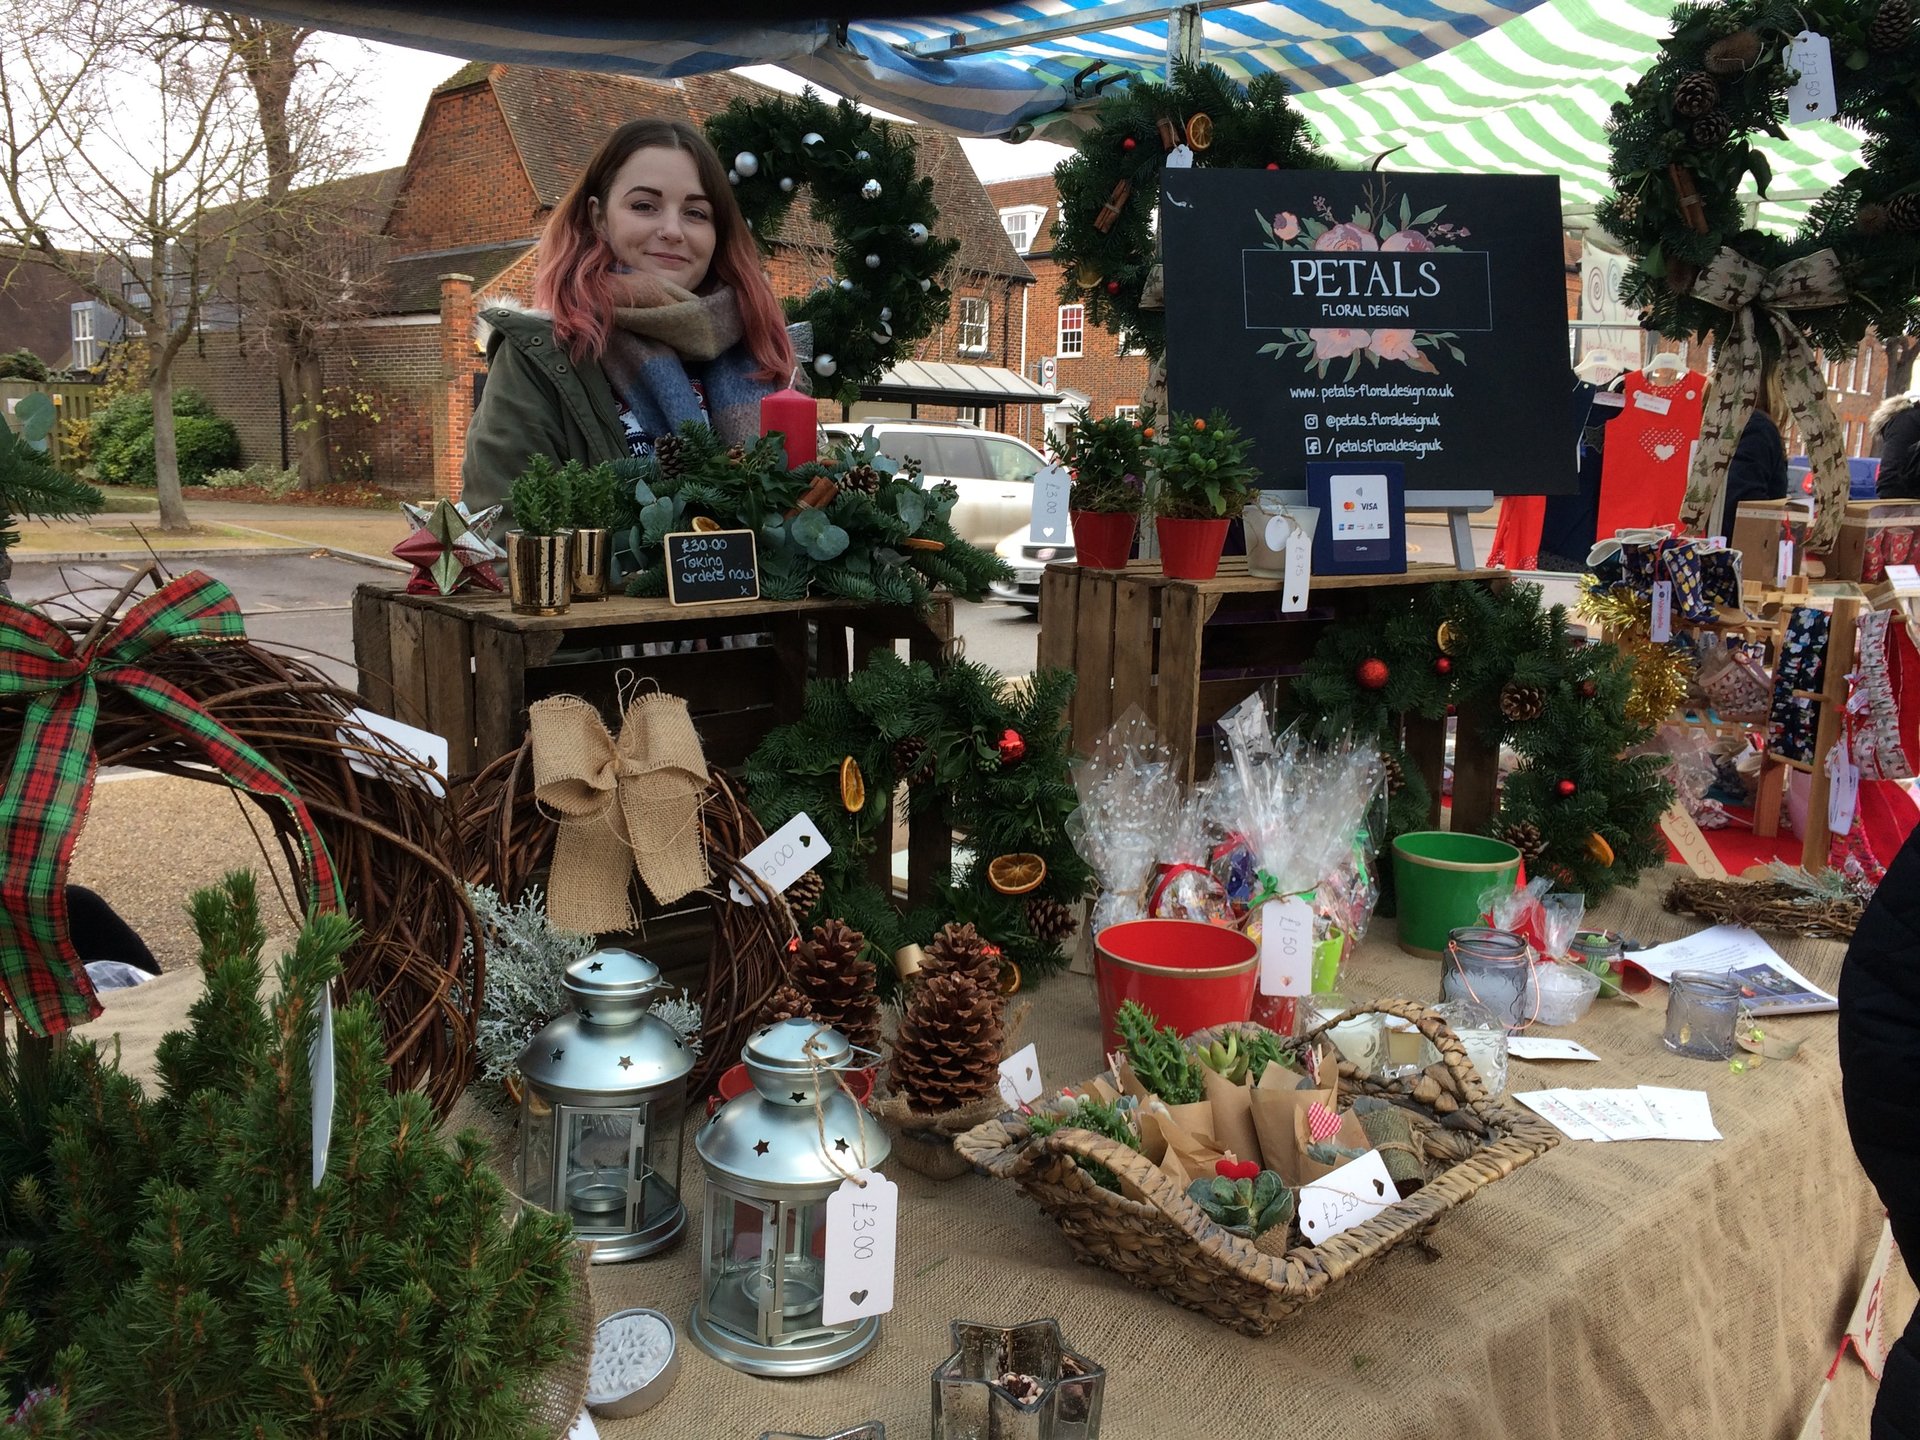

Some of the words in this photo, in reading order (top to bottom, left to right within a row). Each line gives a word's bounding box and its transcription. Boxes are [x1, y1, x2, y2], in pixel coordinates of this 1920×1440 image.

[1290, 259, 1441, 297] PETALS
[1321, 303, 1366, 317] FLORAL
[1368, 304, 1410, 317] DESIGN
[1361, 502, 1378, 511] VISA
[681, 539, 728, 553] £30.00
[676, 553, 725, 573] Taking
[728, 568, 756, 580] now
